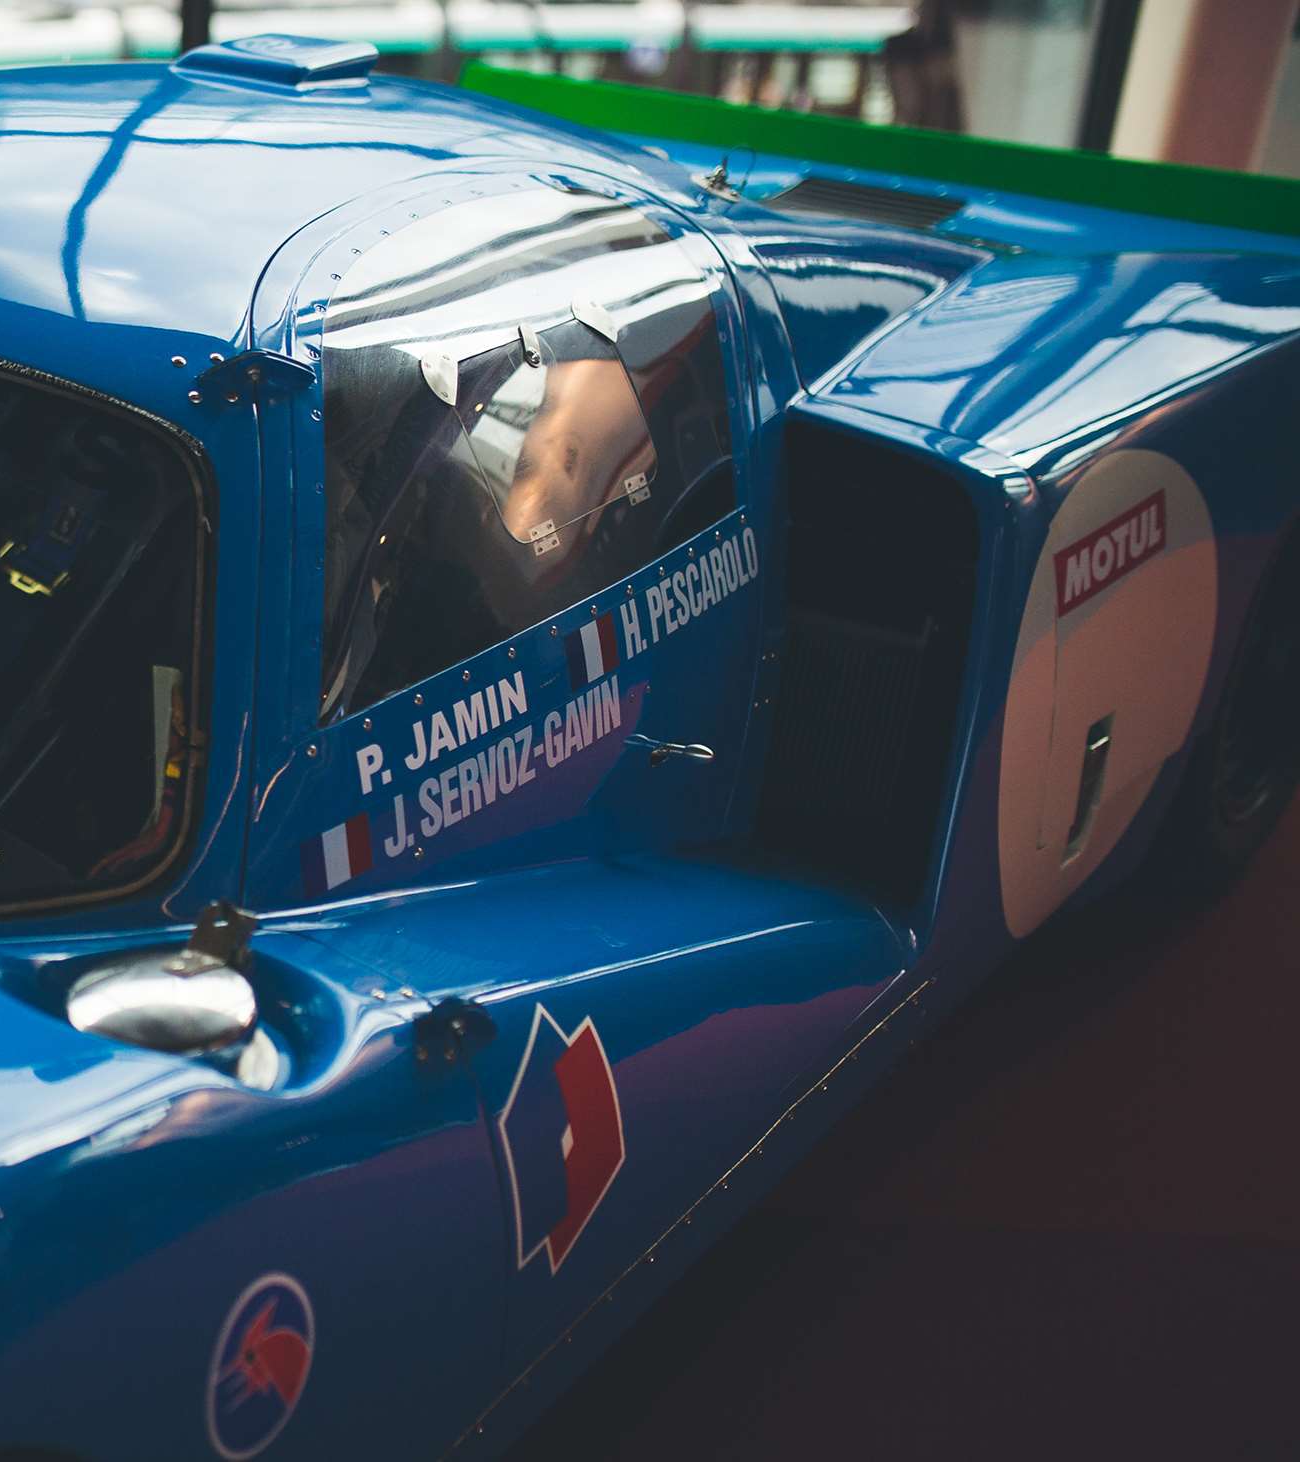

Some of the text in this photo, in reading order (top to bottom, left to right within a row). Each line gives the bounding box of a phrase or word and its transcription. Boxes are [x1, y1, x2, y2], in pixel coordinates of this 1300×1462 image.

[619, 527, 759, 660] H. PESCAROLO
[1063, 503, 1163, 604] MOTUL
[356, 671, 528, 795] P. JAMIN
[384, 675, 621, 858] J. SERVOZ-GAVIN
